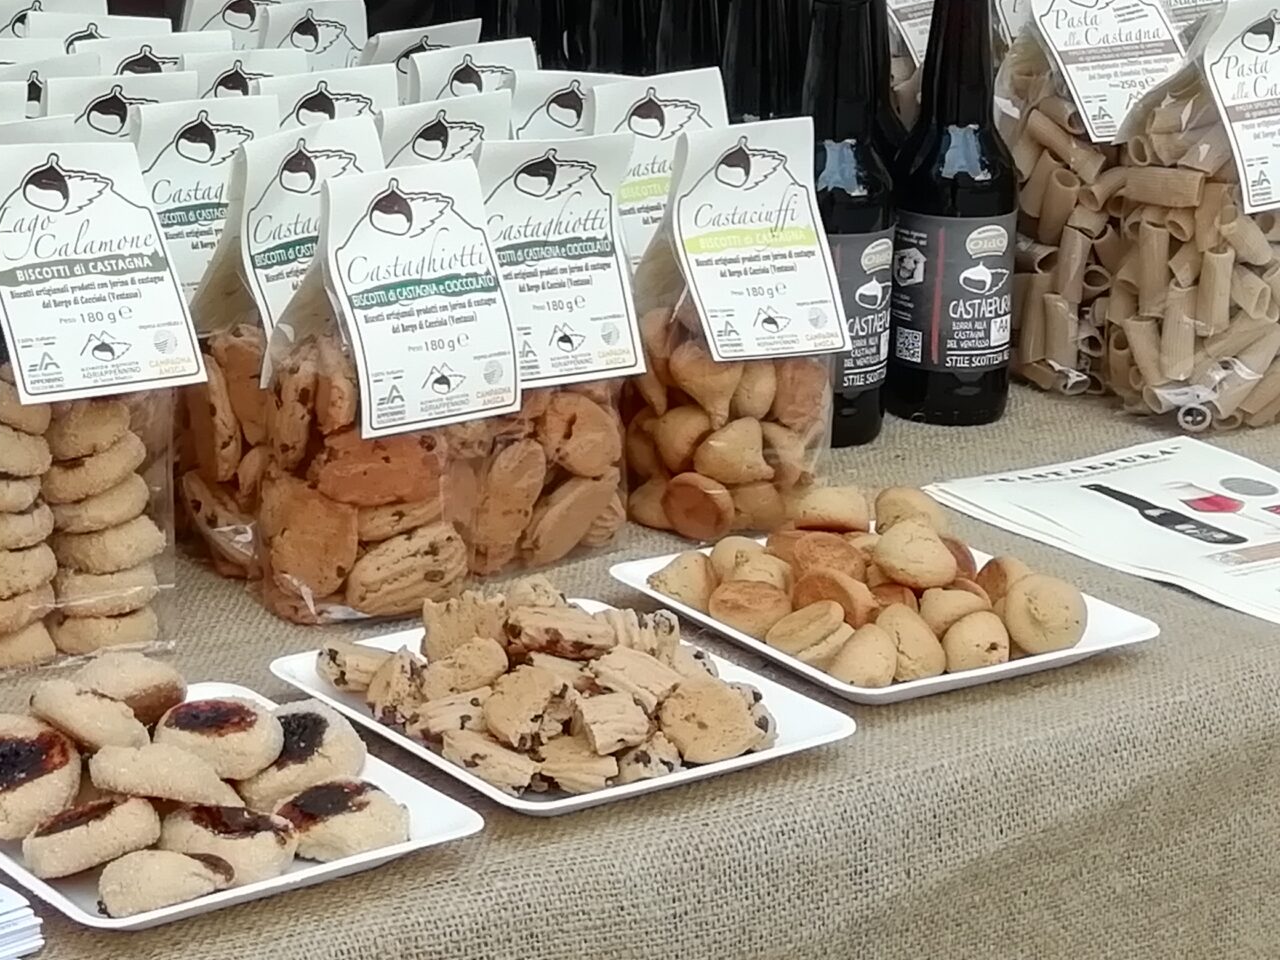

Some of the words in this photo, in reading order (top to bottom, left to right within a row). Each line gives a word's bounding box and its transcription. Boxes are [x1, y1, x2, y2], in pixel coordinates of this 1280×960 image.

[1052, 9, 1099, 30] Pasta
[1084, 27, 1161, 46] Castagna
[1223, 54, 1271, 79] Pasta
[1120, 80, 1137, 89] 250
[151, 178, 225, 205] Castag
[188, 210, 196, 221] di
[196, 207, 228, 221] CASTAG
[486, 191, 608, 243] Castaghiotti
[694, 182, 798, 238] Castaciuffi
[33, 219, 156, 260] Calamone
[347, 227, 485, 285] Castaghiotti
[524, 246, 561, 260] CASTAGNA
[15, 264, 71, 283] BISCOTTI
[73, 261, 86, 276] di
[88, 255, 154, 274] CASTAGNA
[351, 290, 388, 307] BISCOTTI
[388, 290, 396, 300] di
[397, 283, 439, 300] CASTAGNA
[439, 285, 445, 294] e
[745, 286, 765, 297] 180
[766, 287, 775, 298] g
[546, 299, 564, 311] 180
[566, 300, 574, 312] g
[79, 310, 104, 324] 180
[107, 311, 117, 324] g
[847, 307, 891, 337] CASTAEPU
[424, 339, 445, 352] 180
[447, 339, 456, 352] g
[946, 340, 958, 349] DEL
[945, 355, 970, 368] STILE
[843, 374, 865, 387] STILE
